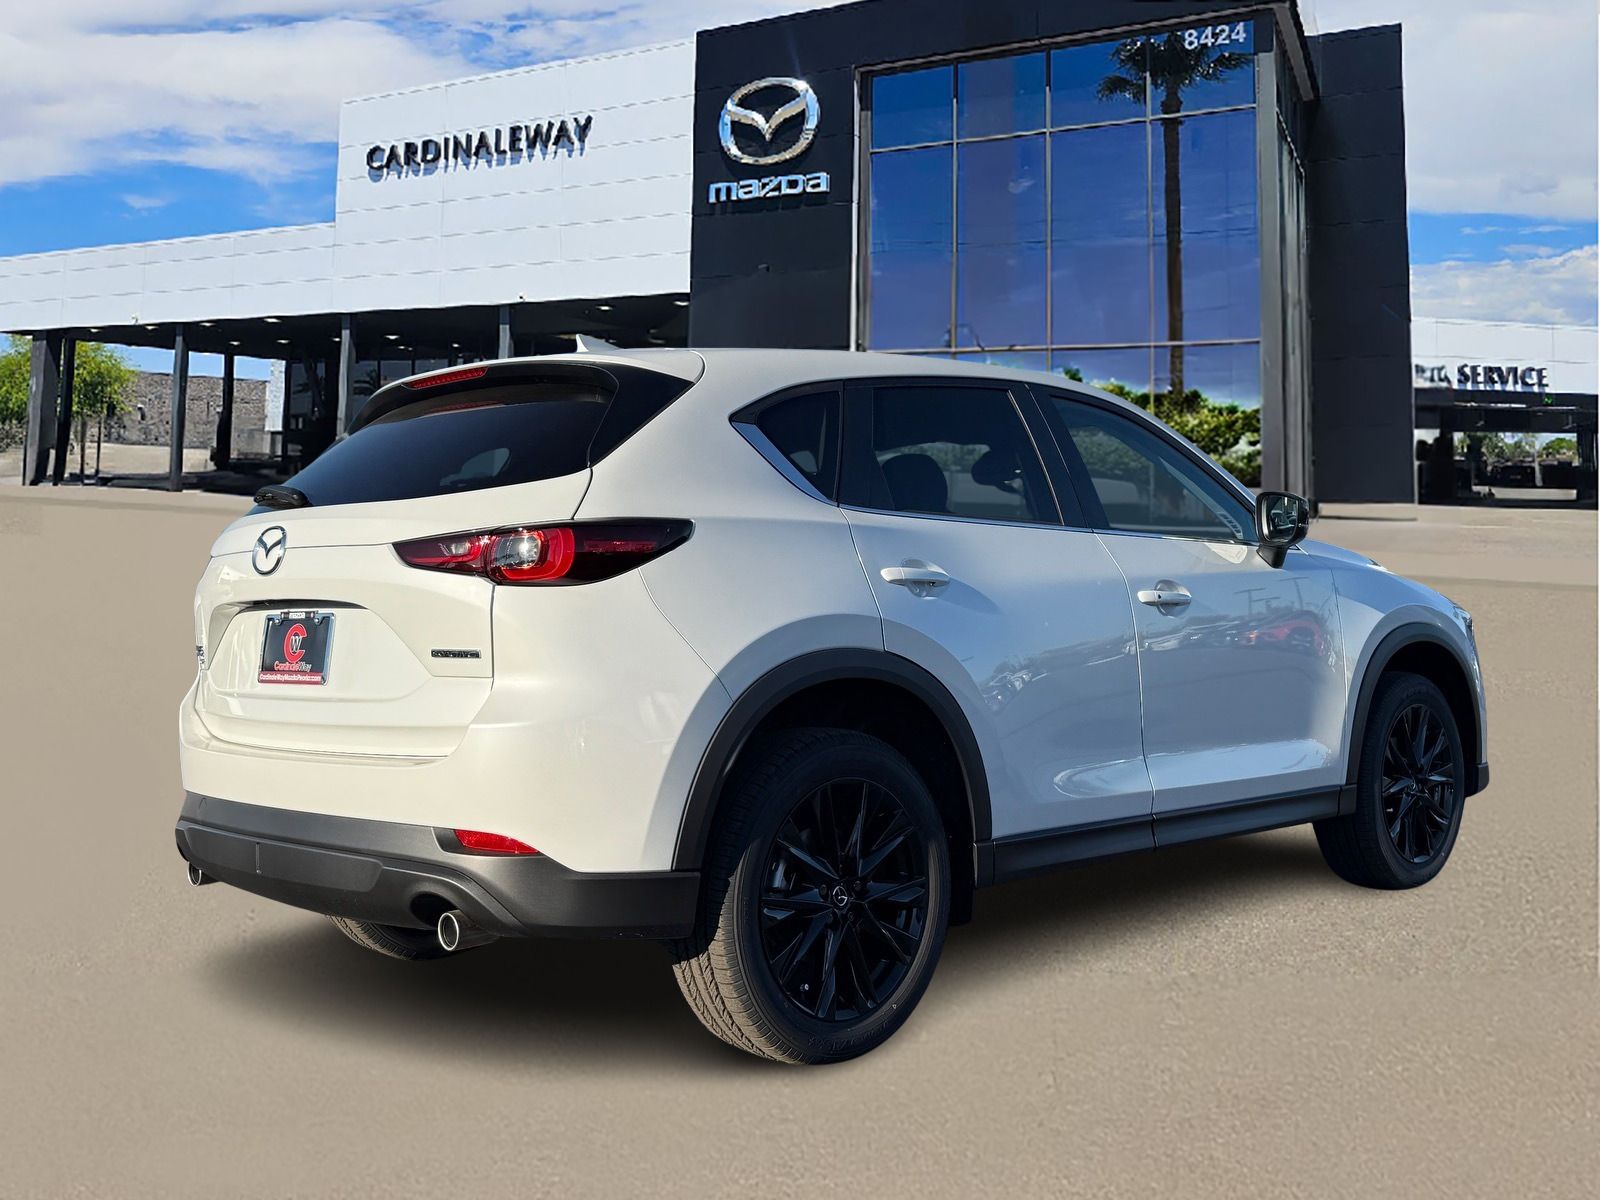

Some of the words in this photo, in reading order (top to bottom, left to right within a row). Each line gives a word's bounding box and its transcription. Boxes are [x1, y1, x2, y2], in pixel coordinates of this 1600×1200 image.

[1184, 21, 1247, 50] 8424
[365, 114, 594, 171] CARDINALEWAY
[1456, 363, 1550, 388] SERVICE
